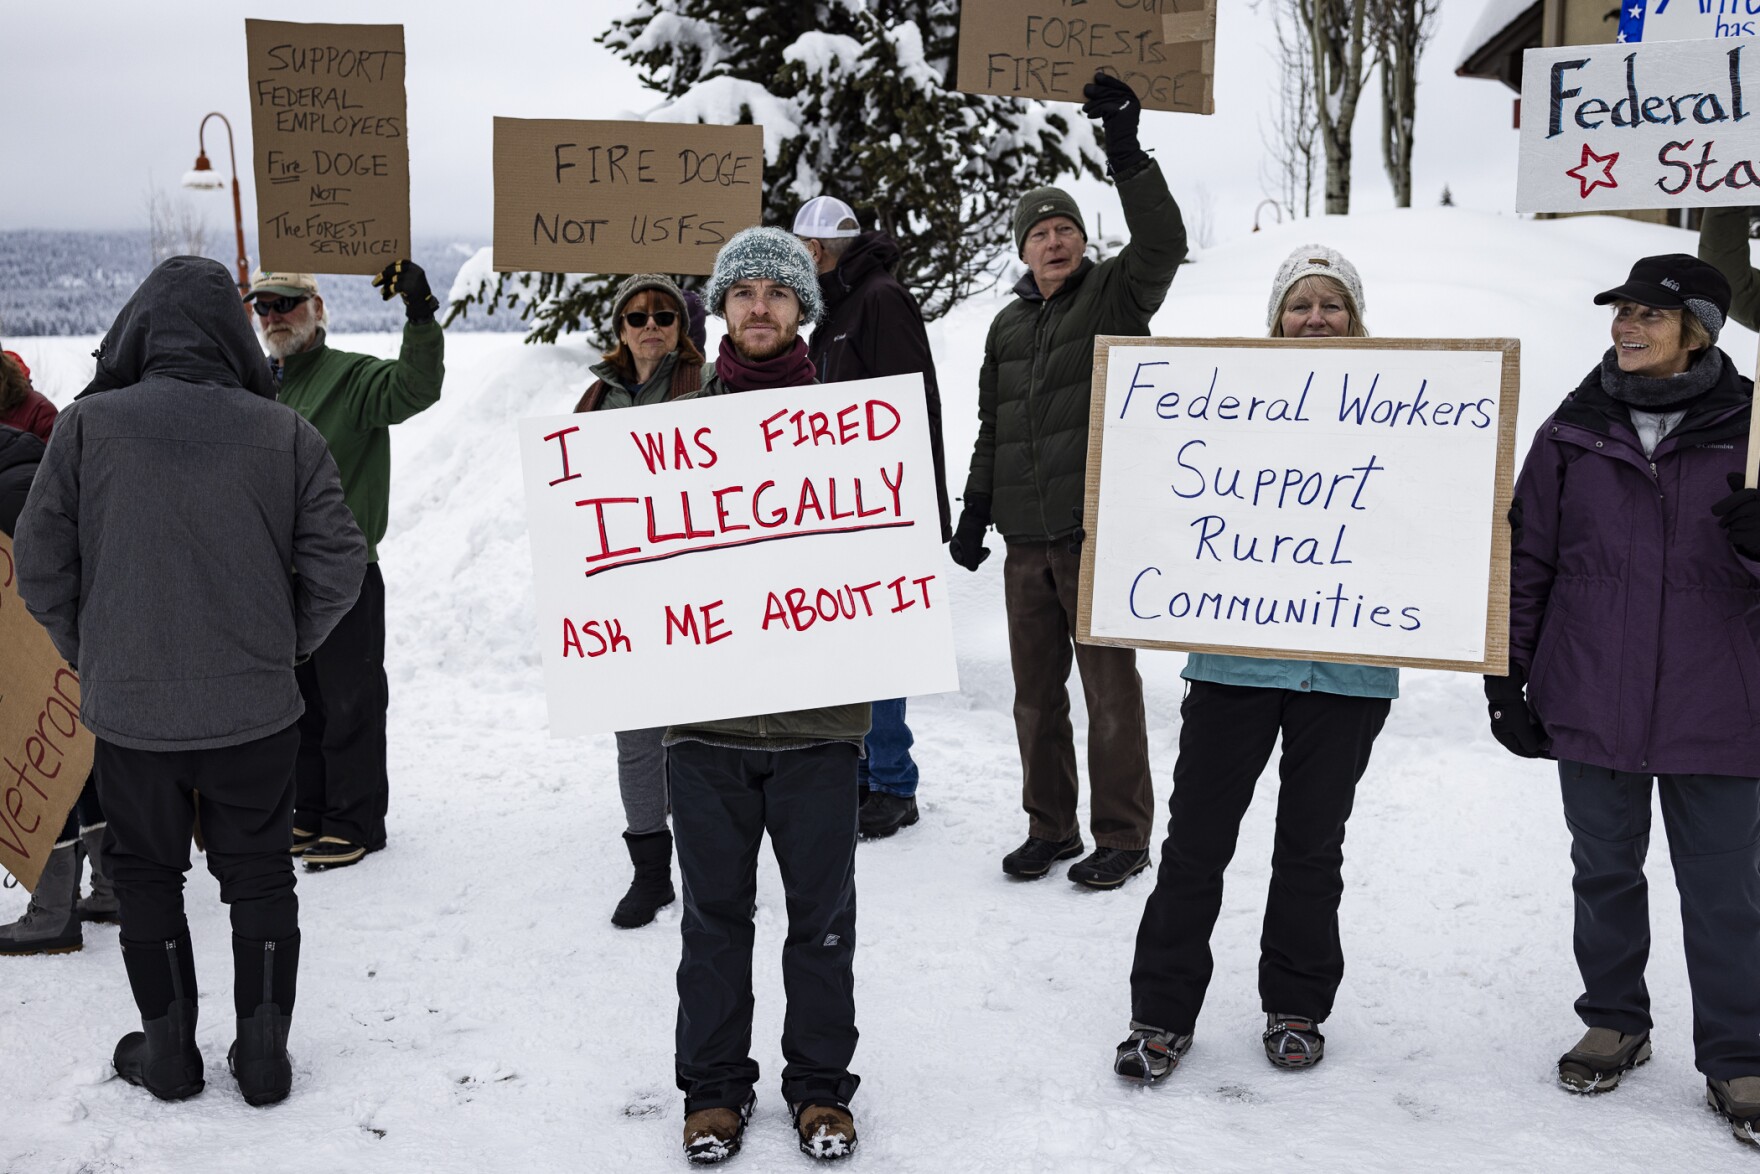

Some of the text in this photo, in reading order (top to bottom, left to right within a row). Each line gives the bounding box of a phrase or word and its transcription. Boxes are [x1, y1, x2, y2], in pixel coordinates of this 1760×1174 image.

[268, 44, 405, 83] SUPPORT
[987, 53, 1075, 94] FIRE
[256, 79, 364, 112] FEDERAL
[1545, 45, 1751, 139] Federal
[276, 109, 401, 138] EMPLOYEES
[268, 150, 388, 176] Fire DOGE
[554, 143, 753, 186] FIRE DOGE
[1654, 138, 1760, 195] Sta
[310, 184, 351, 202] NOT
[266, 211, 303, 239] The
[533, 212, 725, 246] NOT USFS
[309, 239, 398, 256] SERVICE!
[1119, 361, 1496, 428] Federal Workers
[543, 399, 901, 486] I WAS FIRED
[1171, 439, 1384, 510] Support
[575, 461, 904, 562] ILLEGALLY
[1190, 515, 1353, 566] Rural
[664, 599, 733, 645] ME
[761, 580, 881, 632] ABOUT
[887, 575, 936, 614] IT
